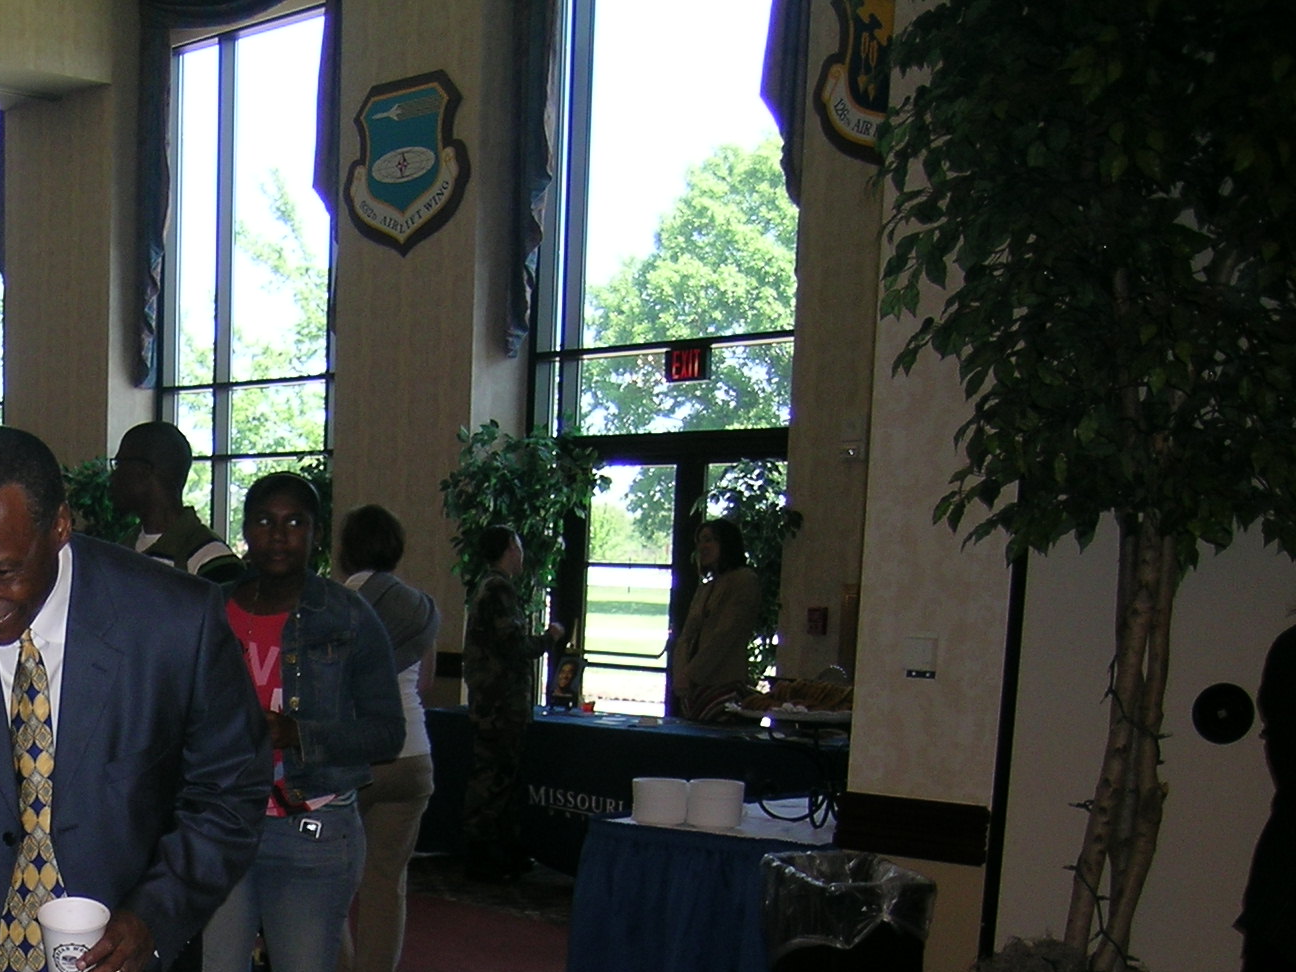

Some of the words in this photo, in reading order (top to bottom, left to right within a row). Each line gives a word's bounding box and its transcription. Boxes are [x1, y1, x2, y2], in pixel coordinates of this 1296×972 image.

[380, 208, 423, 234] AIRLIFT
[424, 181, 450, 213] WING
[672, 349, 702, 379] EXIT
[527, 783, 625, 814] MISSOURI
